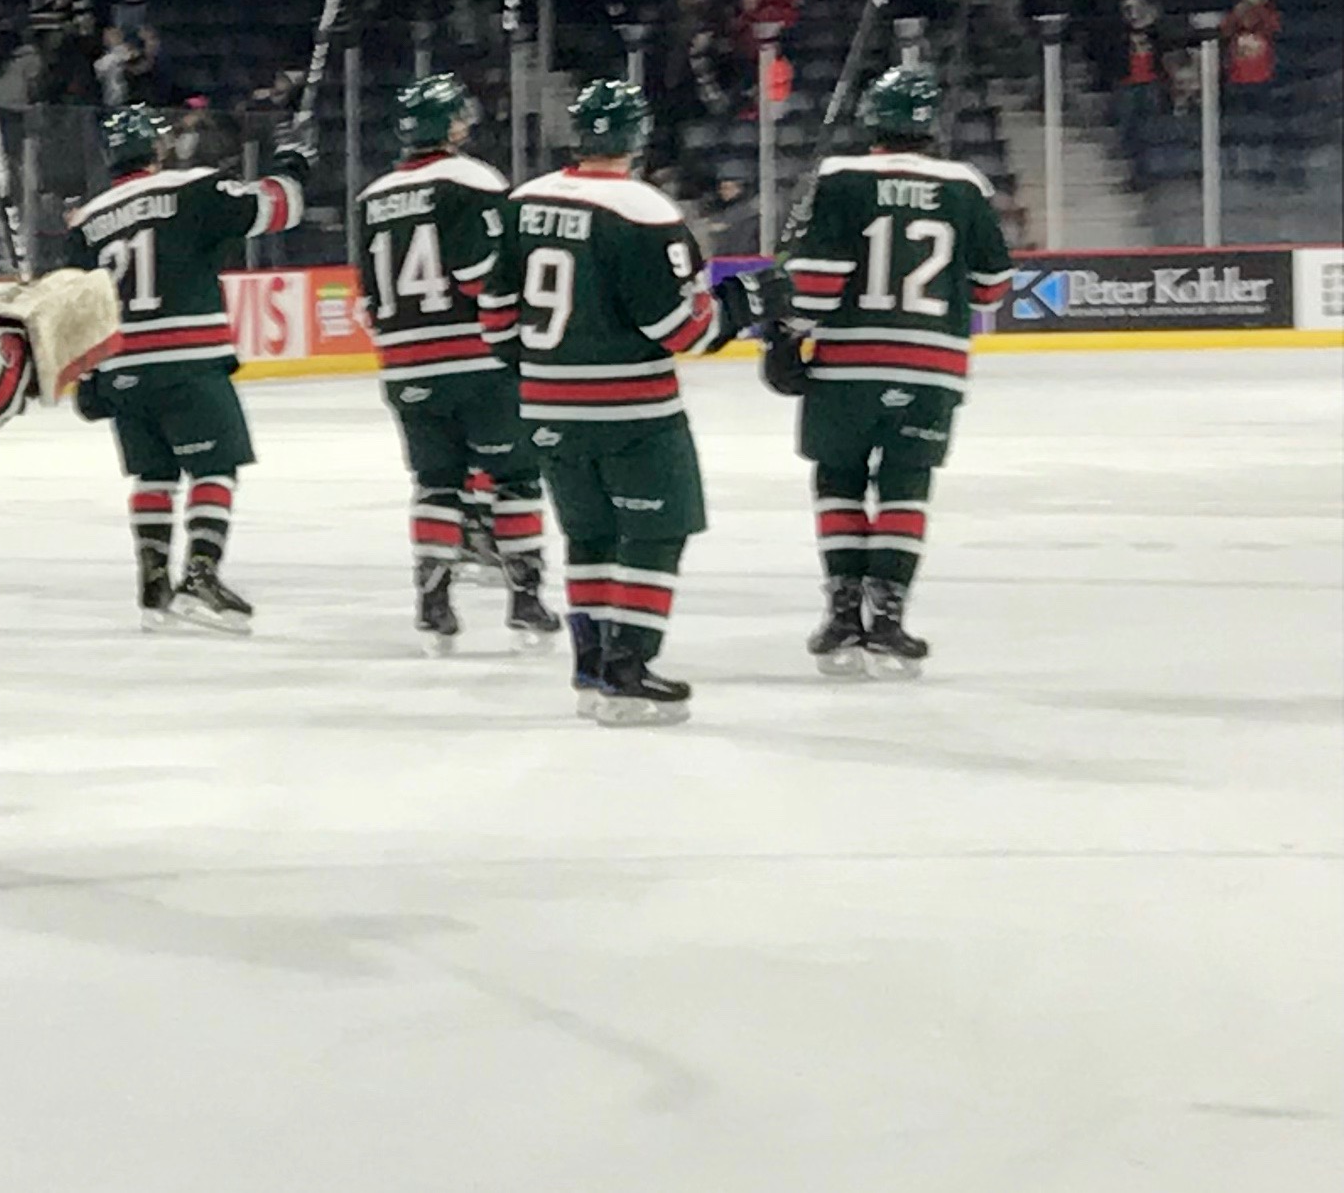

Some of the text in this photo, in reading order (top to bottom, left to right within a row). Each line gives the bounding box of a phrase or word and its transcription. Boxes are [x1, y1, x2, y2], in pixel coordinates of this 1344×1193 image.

[369, 223, 452, 320] 14
[519, 247, 574, 350] 9
[665, 242, 692, 278] 9
[858, 215, 956, 316] 12
[1069, 267, 1274, 305] Peter Kohler
